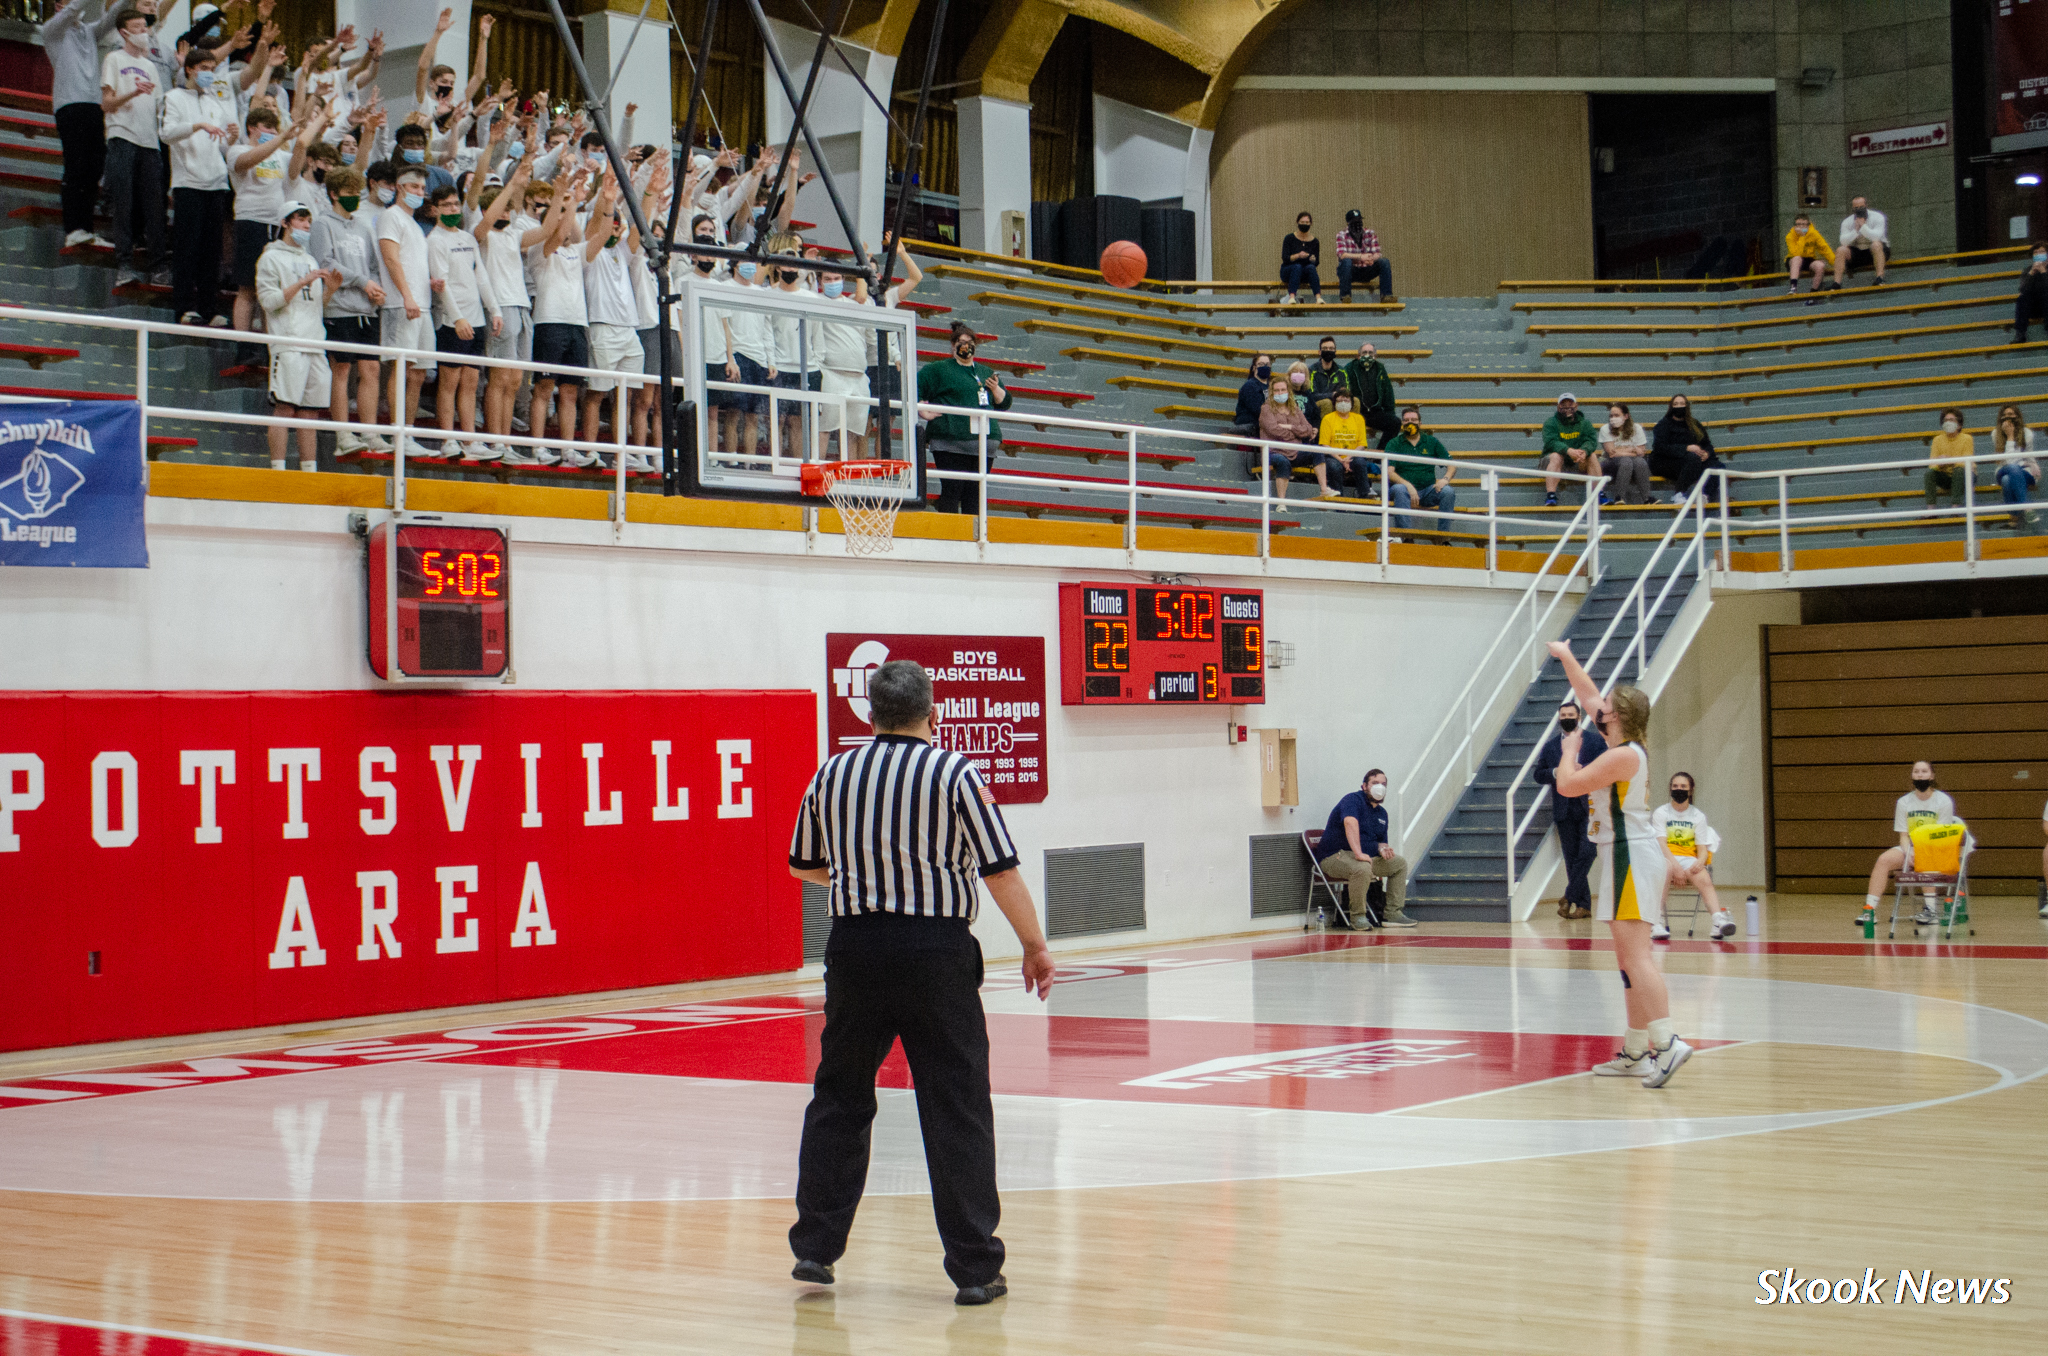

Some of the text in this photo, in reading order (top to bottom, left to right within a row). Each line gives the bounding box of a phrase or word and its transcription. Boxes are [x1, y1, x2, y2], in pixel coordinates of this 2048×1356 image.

[2019, 76, 2048, 89] DISTRI
[1859, 135, 1932, 153] RESTROOMS
[0, 418, 96, 454] chuylkill
[0, 518, 77, 547] League
[423, 551, 500, 597] 5:02
[1090, 590, 1122, 614] Home
[1155, 591, 1214, 639] 5:02
[1223, 596, 1259, 618] Guests
[953, 651, 998, 665] BOYS
[1093, 622, 1128, 669] 22
[1245, 626, 1261, 671] 9
[926, 667, 1026, 681] BASKETBALL
[1160, 673, 1195, 697] period
[1206, 665, 1217, 698] 3
[934, 697, 1041, 723] ylkill League
[994, 757, 1015, 769] 1993
[1018, 757, 1039, 769] 1995
[994, 772, 1015, 784] 2015
[1018, 771, 1039, 783] 2016
[0, 739, 753, 853] POTTSVILLE
[268, 861, 557, 970] AREA
[0, 1004, 811, 1101] IMSON
